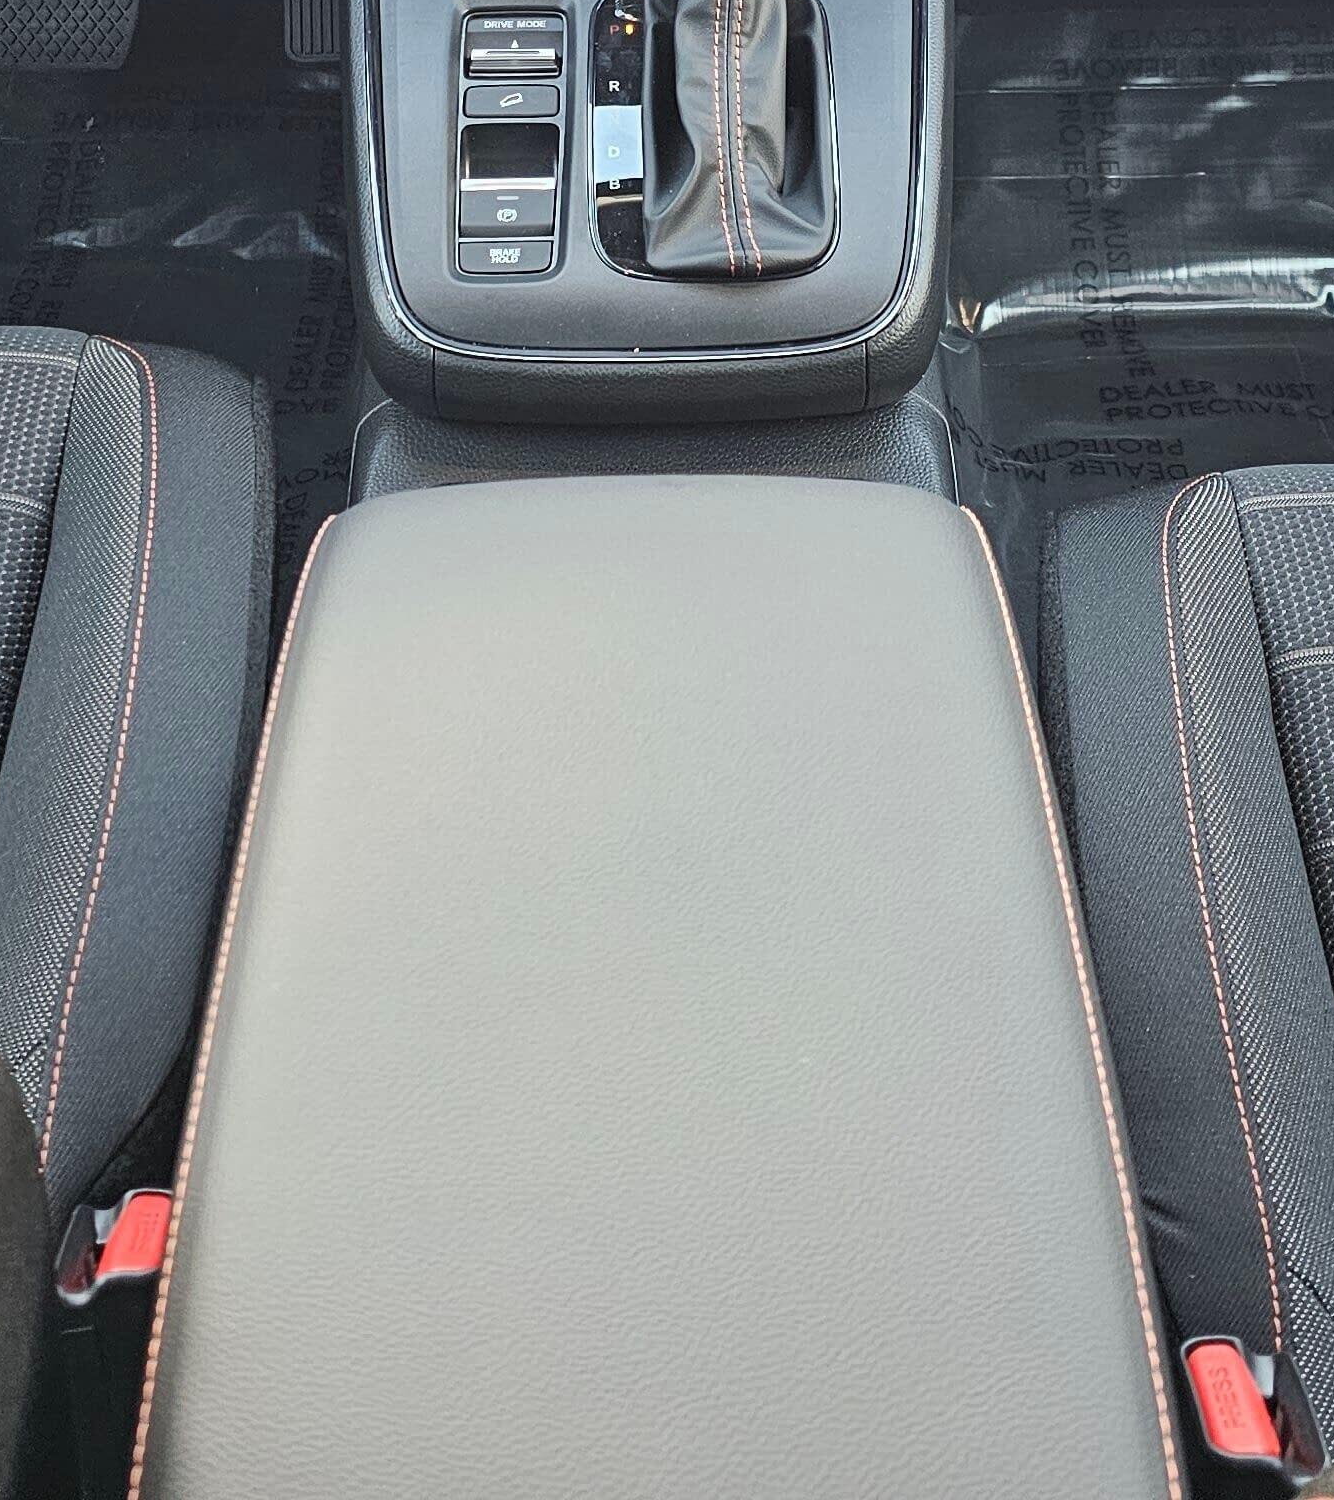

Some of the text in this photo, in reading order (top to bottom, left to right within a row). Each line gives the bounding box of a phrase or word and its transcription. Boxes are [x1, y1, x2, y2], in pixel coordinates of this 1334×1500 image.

[483, 19, 547, 29] DRIVE MODE
[609, 24, 619, 35] P
[608, 80, 620, 92] R
[1089, 91, 1122, 190] DEALER
[607, 145, 620, 158] D
[1056, 91, 1097, 250] PROTECTIVE
[1100, 206, 1132, 275] MUST
[489, 247, 521, 257] BRAKE
[490, 254, 519, 264] HOLD
[1097, 377, 1217, 404] DEALER
[1235, 380, 1316, 401] MUST
[1104, 398, 1296, 423] PROTECTIVE
[1069, 459, 1190, 481] DEALER
